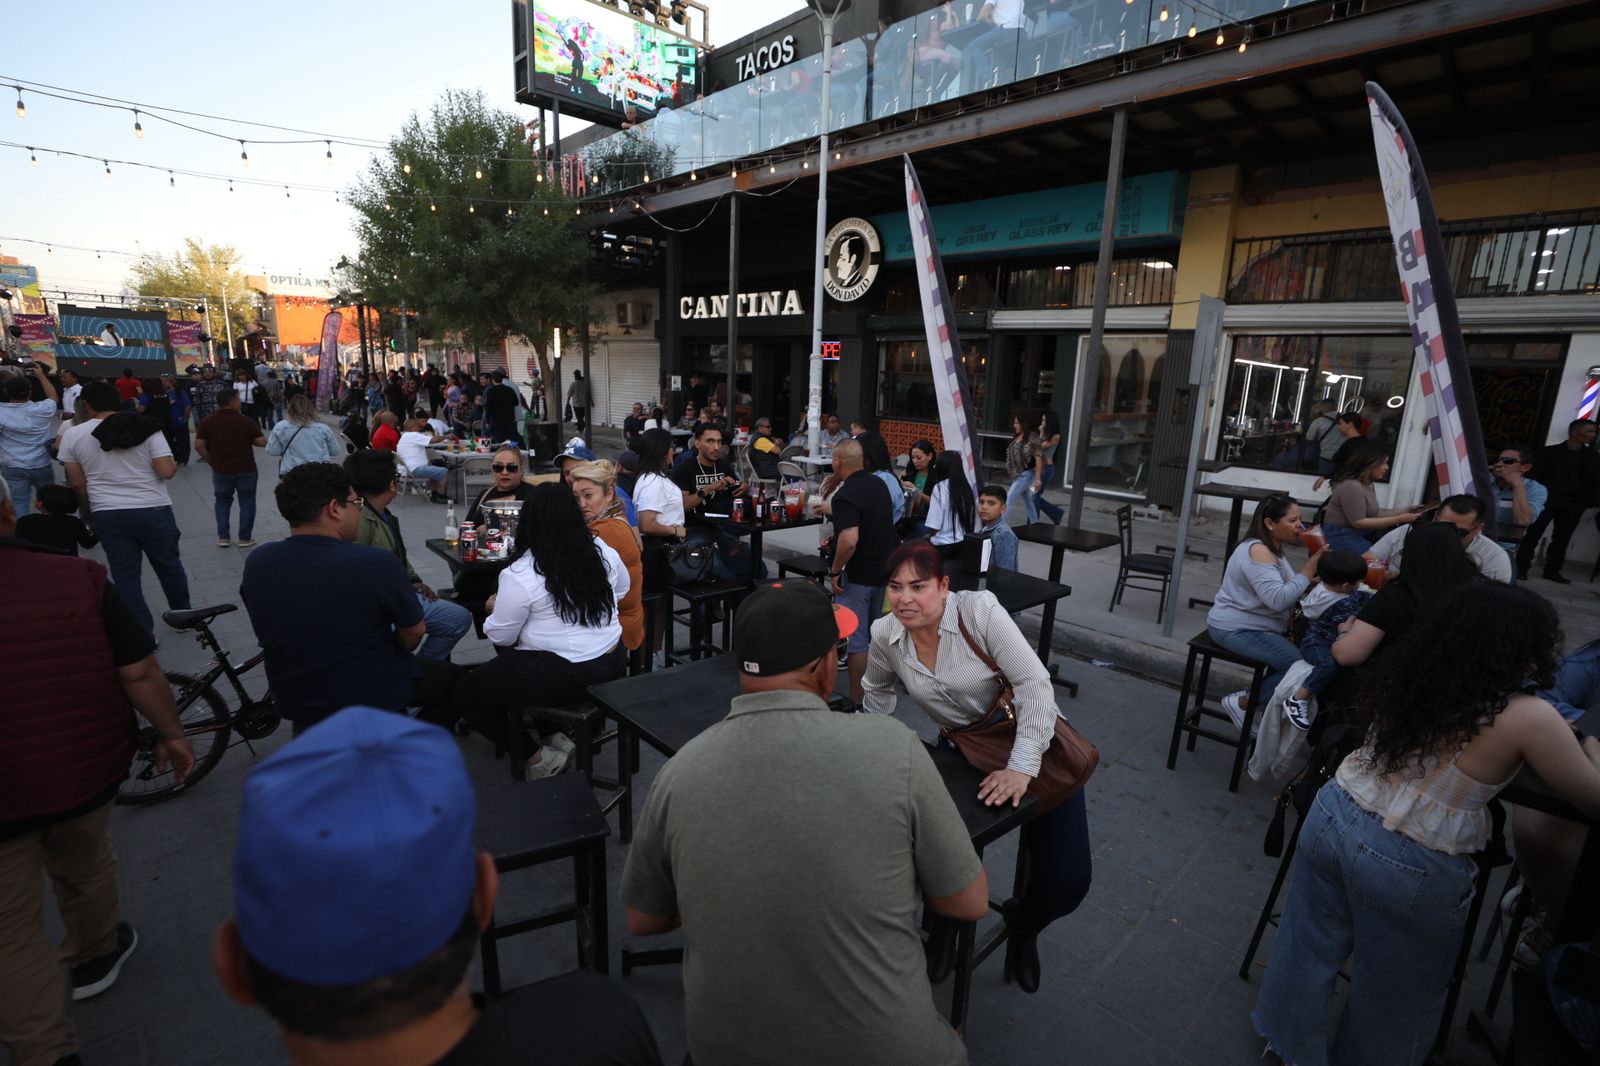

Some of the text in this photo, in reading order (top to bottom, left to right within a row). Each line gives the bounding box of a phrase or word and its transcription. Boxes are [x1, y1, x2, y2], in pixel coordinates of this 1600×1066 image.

[735, 34, 794, 82] TACOS
[976, 229, 998, 243] REY
[1009, 224, 1048, 240] GLASS
[1047, 220, 1072, 236] REY
[270, 275, 312, 287] OPTICA
[826, 278, 870, 300] DON DAVID
[680, 290, 803, 319] CANTINA
[820, 343, 841, 358] OPE
[698, 475, 722, 484] GUESS
